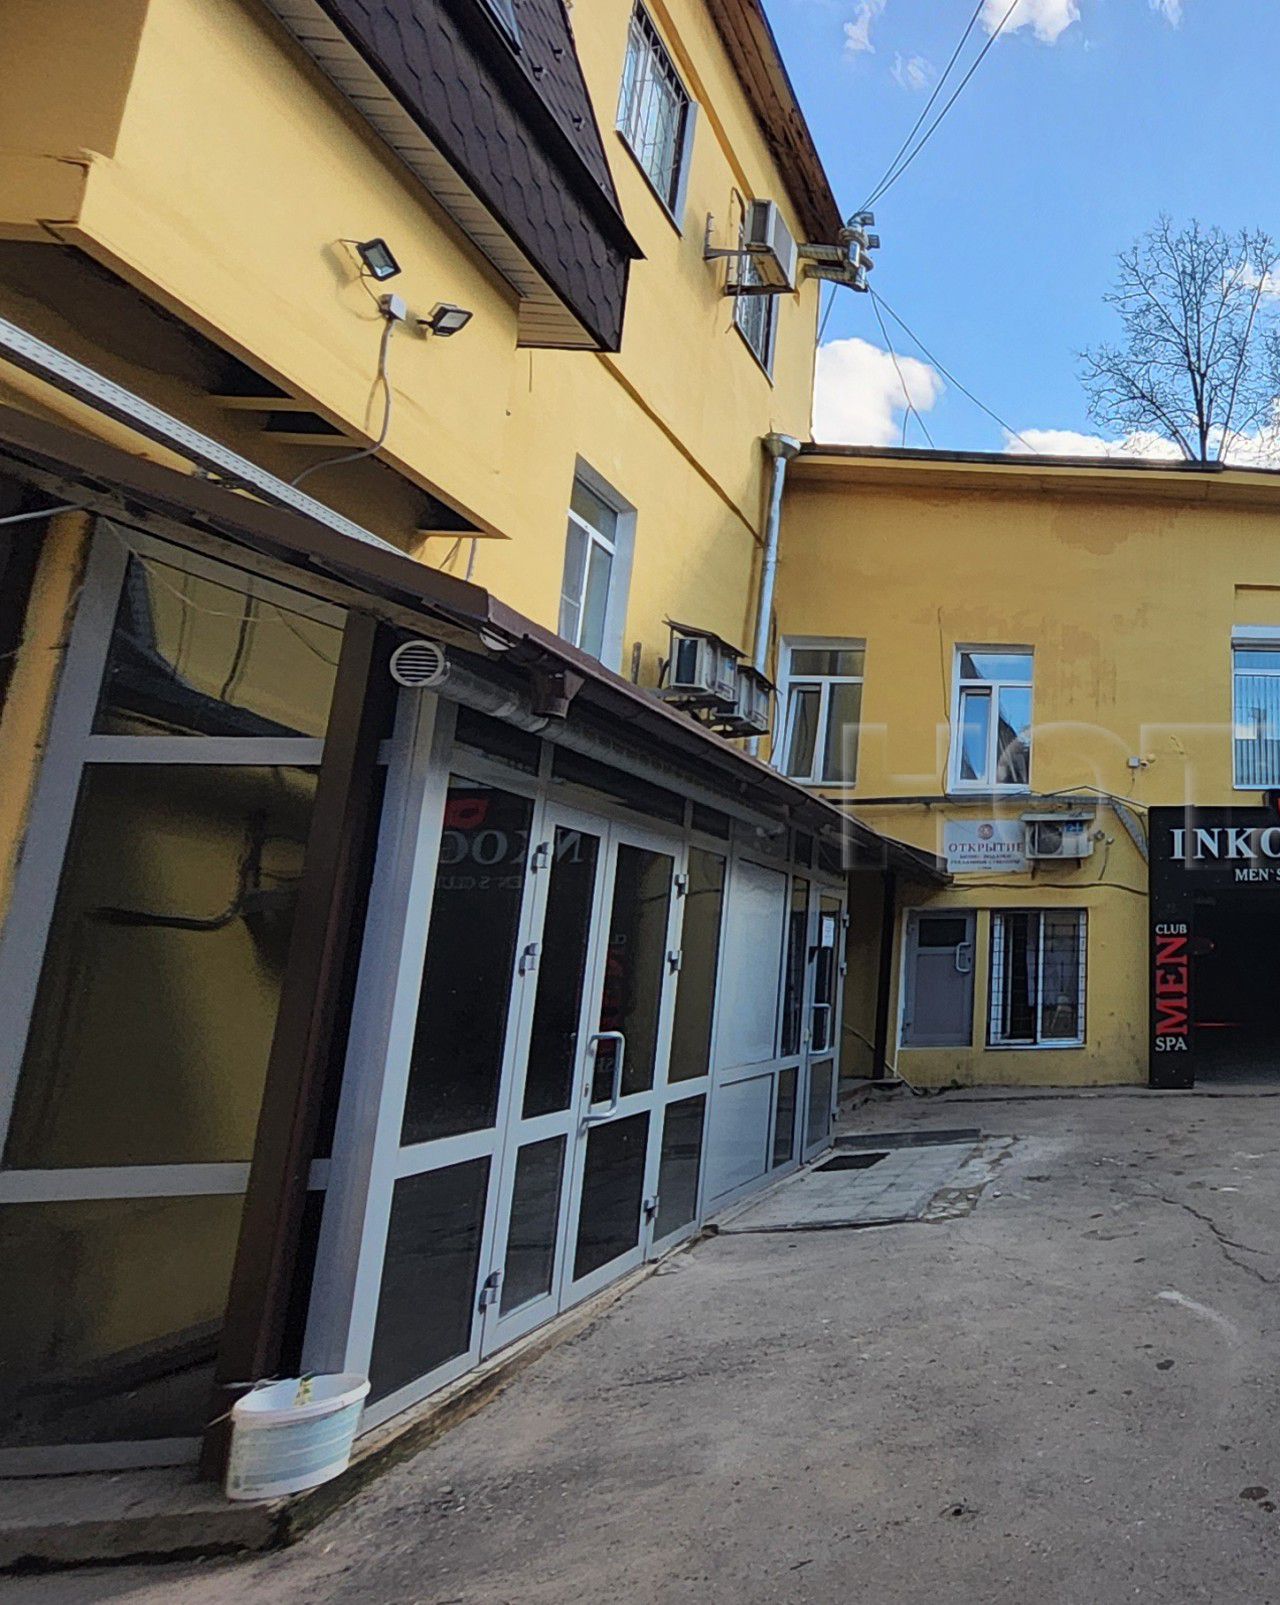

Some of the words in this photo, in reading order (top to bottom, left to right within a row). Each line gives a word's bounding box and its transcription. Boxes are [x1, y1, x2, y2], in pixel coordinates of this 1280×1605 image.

[948, 842, 1024, 853] ОТКРЫТИЕ
[1155, 923, 1188, 935] CLUB
[1155, 935, 1188, 1036] MEN
[1155, 1036, 1188, 1051] SPA
